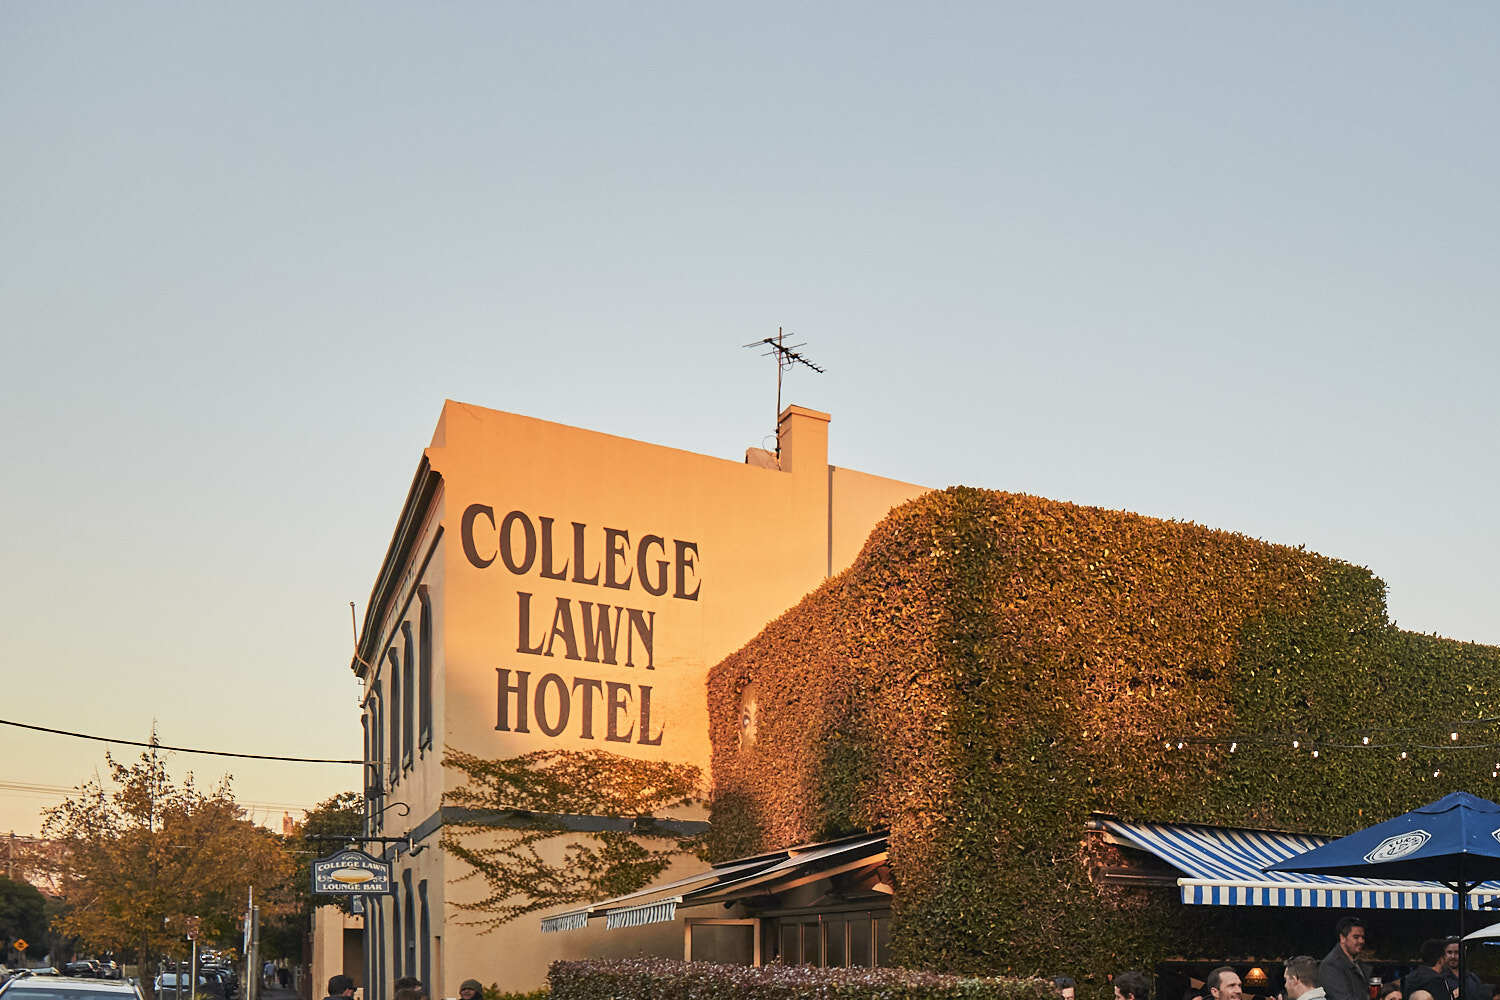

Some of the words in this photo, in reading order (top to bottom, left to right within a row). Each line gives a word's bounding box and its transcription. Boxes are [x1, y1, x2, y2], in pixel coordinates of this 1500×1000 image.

[461, 503, 701, 601] COLLEGE
[516, 591, 656, 670] LAWN
[494, 667, 665, 746] HOTEL
[318, 861, 360, 871] COLLEGE
[362, 862, 386, 872] LAWN
